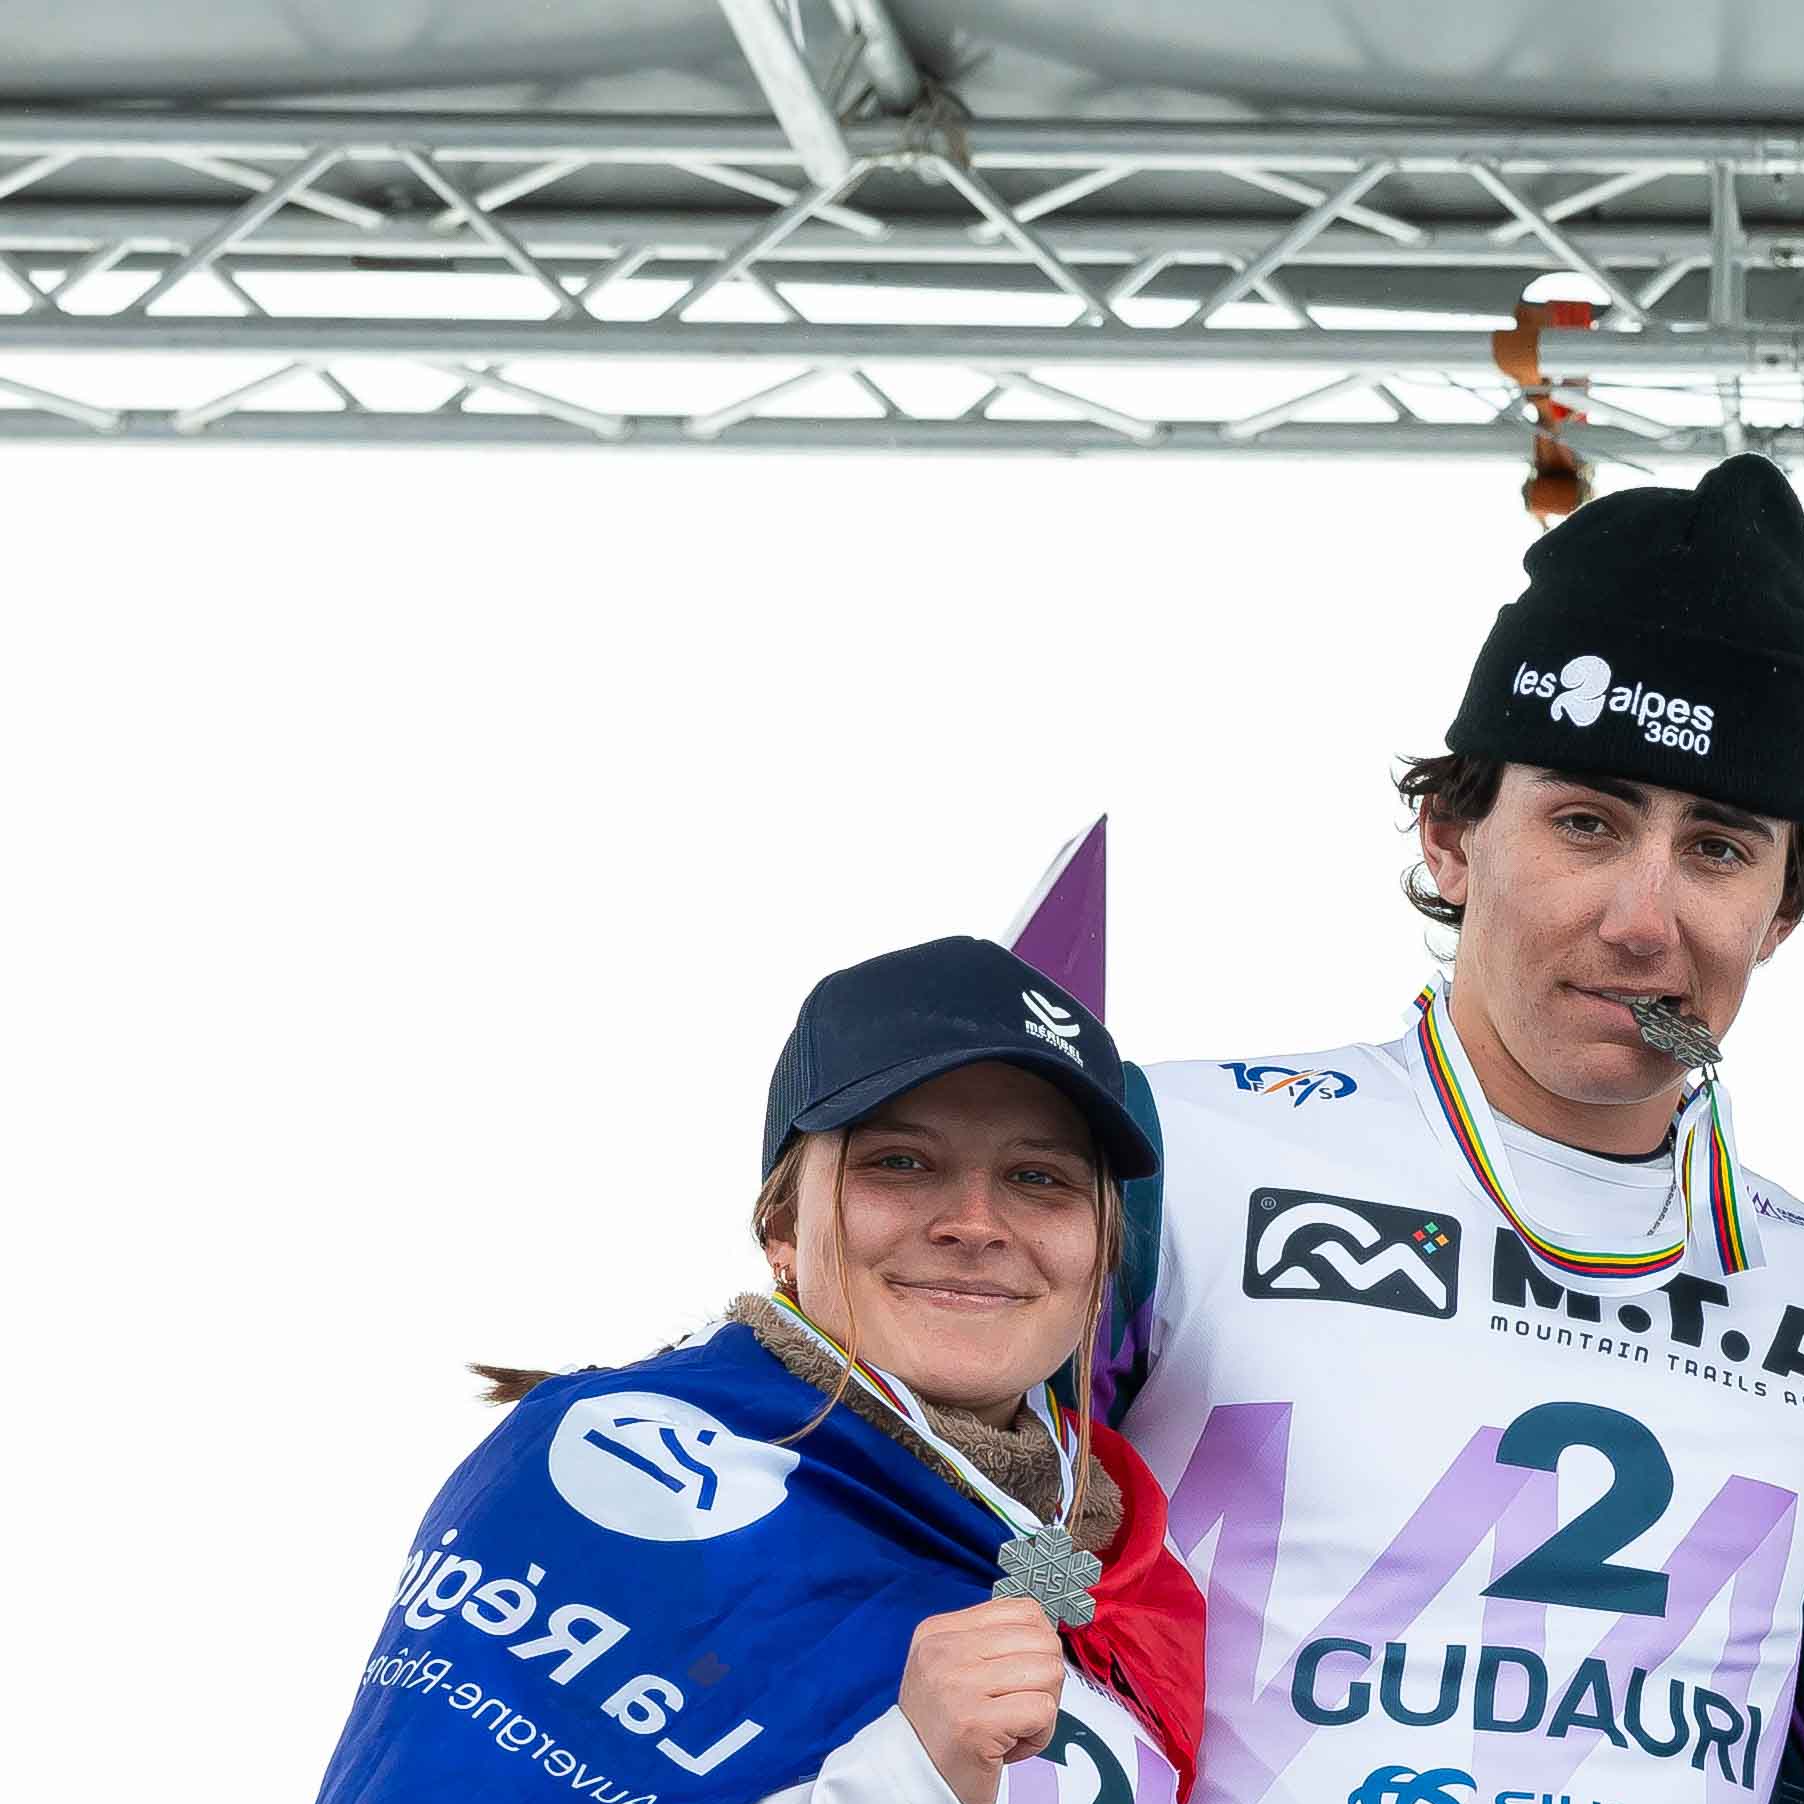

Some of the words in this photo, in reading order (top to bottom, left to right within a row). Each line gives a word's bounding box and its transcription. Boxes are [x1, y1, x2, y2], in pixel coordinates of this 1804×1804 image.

[1644, 720, 1711, 755] 3600
[1490, 1314, 1650, 1364] MOUNTAIN
[1667, 1353, 1768, 1398] TRAILS
[1479, 1401, 1675, 1618] 2
[1290, 1637, 1763, 1791] GUDAURI
